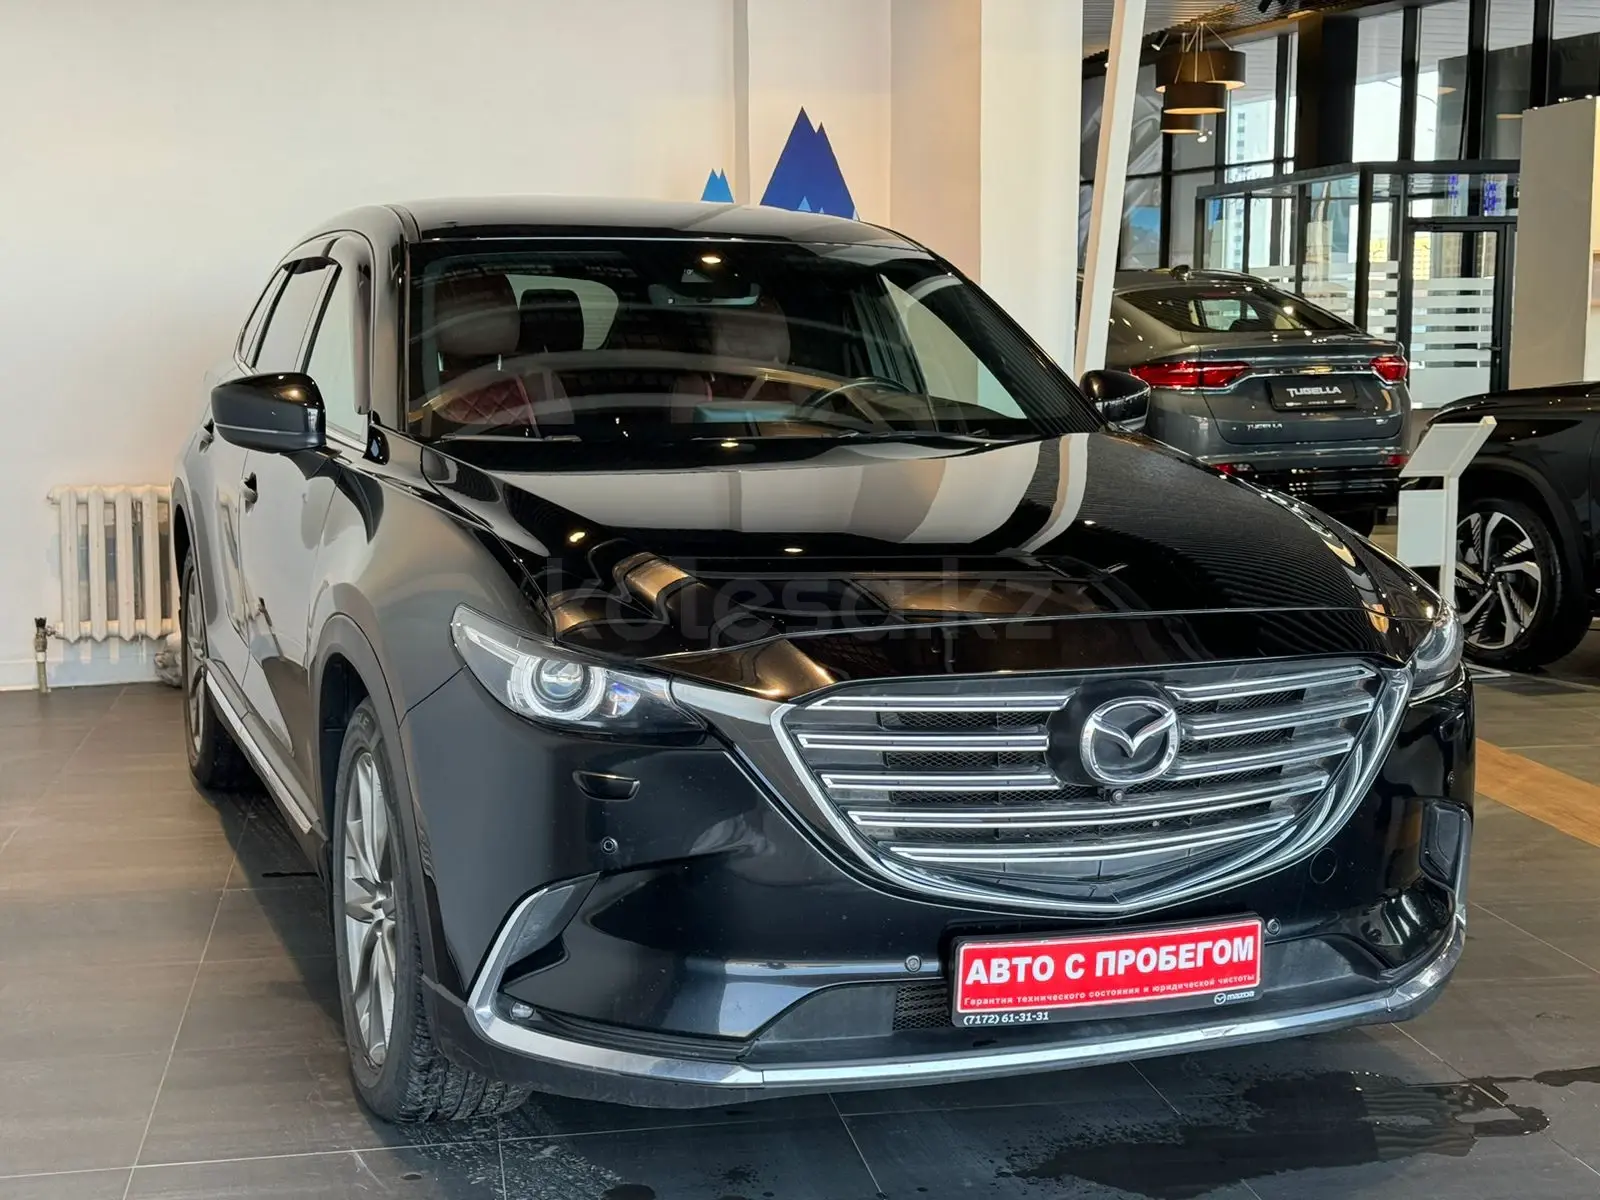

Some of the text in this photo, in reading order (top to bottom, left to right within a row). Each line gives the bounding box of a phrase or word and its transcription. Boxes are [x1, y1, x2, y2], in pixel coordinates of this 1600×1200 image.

[965, 936, 1254, 985] АВТО С ПРОБЕГОМ
[963, 997, 1013, 1007] Гарантия
[1017, 992, 1086, 1003] технического
[1088, 988, 1140, 998] состояния
[1152, 979, 1215, 993] юридической
[1217, 974, 1255, 985] чистоты
[963, 1011, 1049, 1025] (7172) 61-31-31
